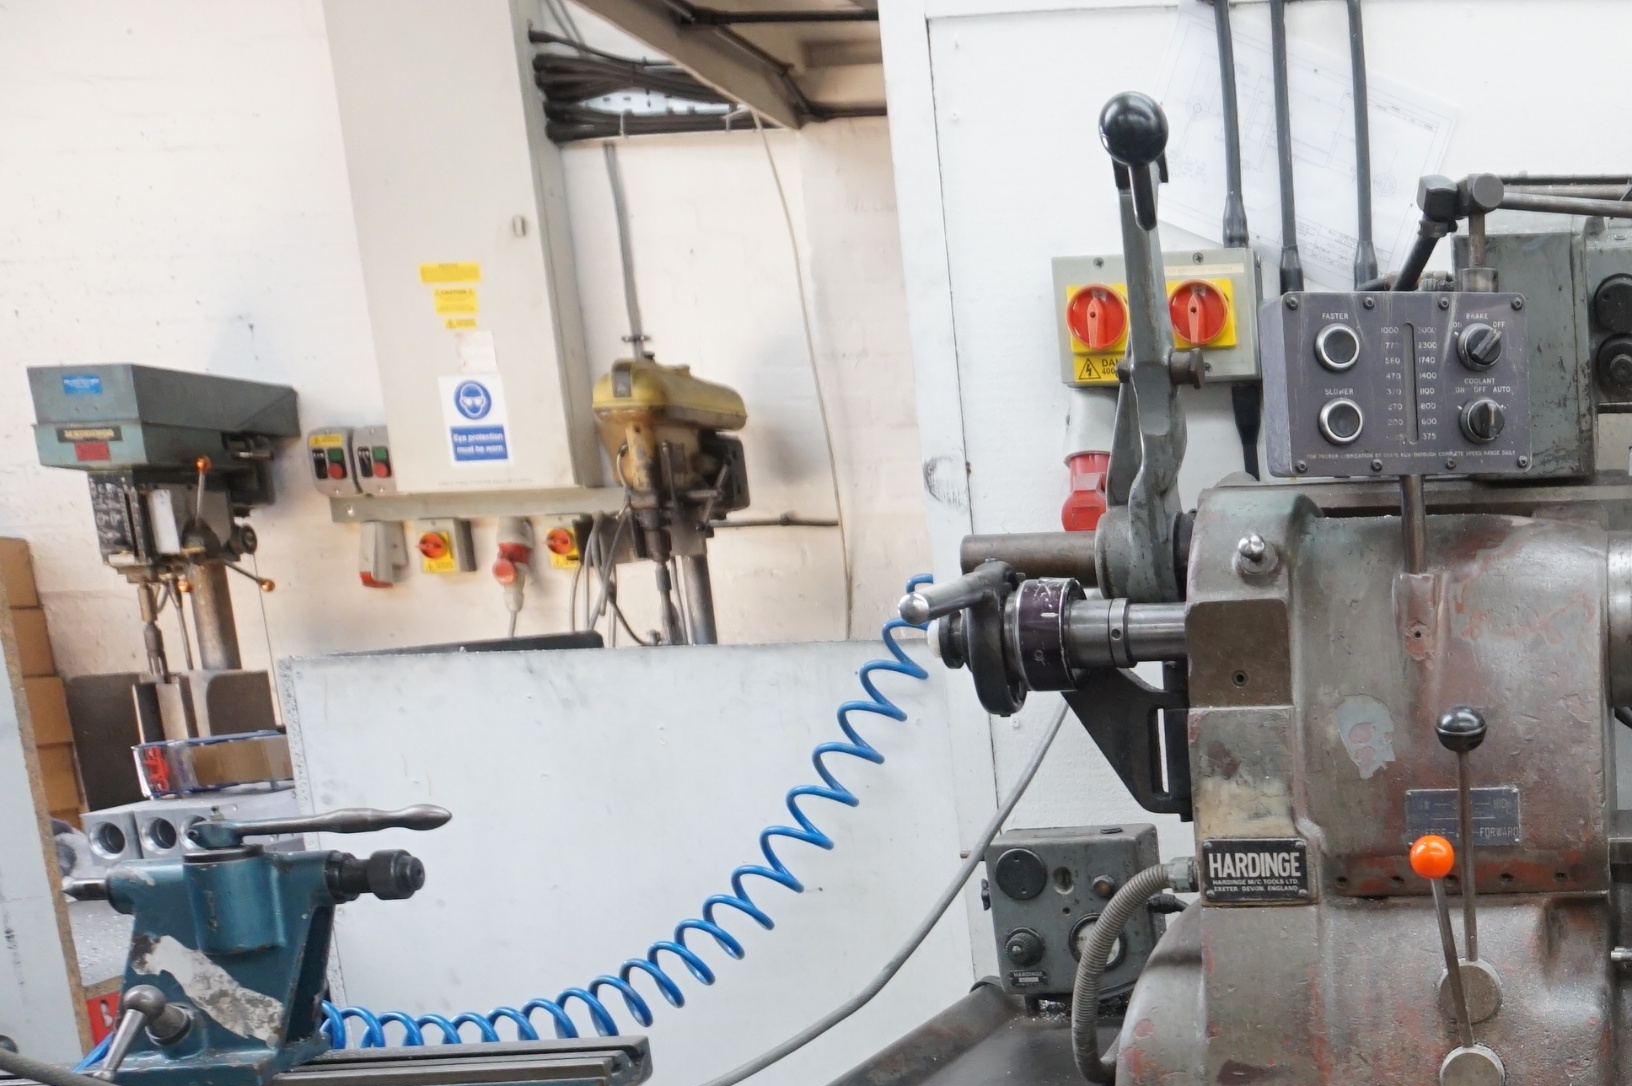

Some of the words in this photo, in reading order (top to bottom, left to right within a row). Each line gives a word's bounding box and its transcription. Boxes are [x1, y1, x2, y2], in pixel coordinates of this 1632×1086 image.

[1321, 312, 1349, 320] FASTER
[1381, 326, 1399, 334] 1000
[1418, 341, 1437, 349] 2300
[1386, 372, 1401, 380] 470
[1419, 371, 1437, 379] 1400
[1420, 387, 1435, 395] 1100
[1492, 385, 1511, 393] AUTO
[1420, 402, 1436, 410] 800
[1421, 417, 1437, 425] 600
[453, 433, 467, 443] Eye
[1421, 432, 1437, 440] 375
[1479, 826, 1519, 837] FORWARD
[1208, 852, 1301, 878] HARDINGE
